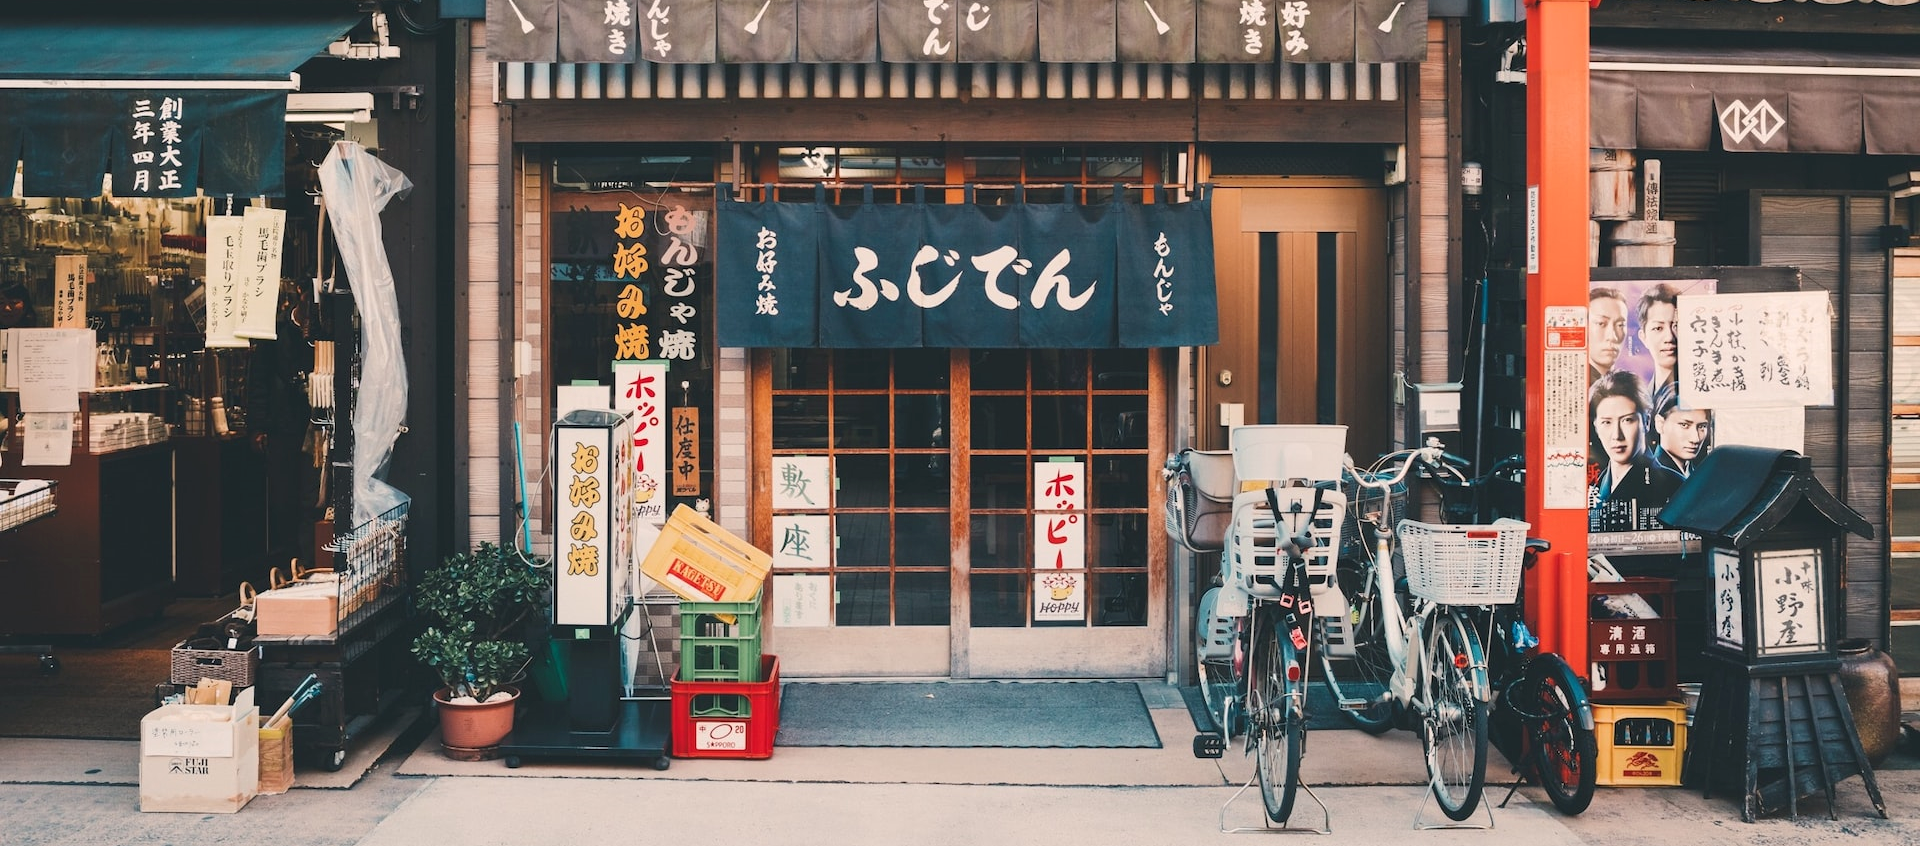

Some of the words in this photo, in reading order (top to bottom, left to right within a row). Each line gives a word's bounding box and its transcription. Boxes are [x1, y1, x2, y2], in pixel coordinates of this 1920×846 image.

[132, 99, 155, 192] 三年四月
[158, 97, 183, 191] 創業大正
[612, 202, 650, 360] お好み焼
[659, 204, 698, 361] もんじゃ焼
[755, 226, 779, 316] お好み焼
[832, 245, 1097, 311] ふじでん
[1153, 231, 1174, 317] もんじゃ
[675, 415, 696, 481] 仕度中
[567, 442, 601, 577] お好み焼
[1045, 469, 1078, 570] ホッピー
[1609, 626, 1647, 641] 清酒
[185, 766, 209, 775] STAR
[735, 725, 744, 734] 20
